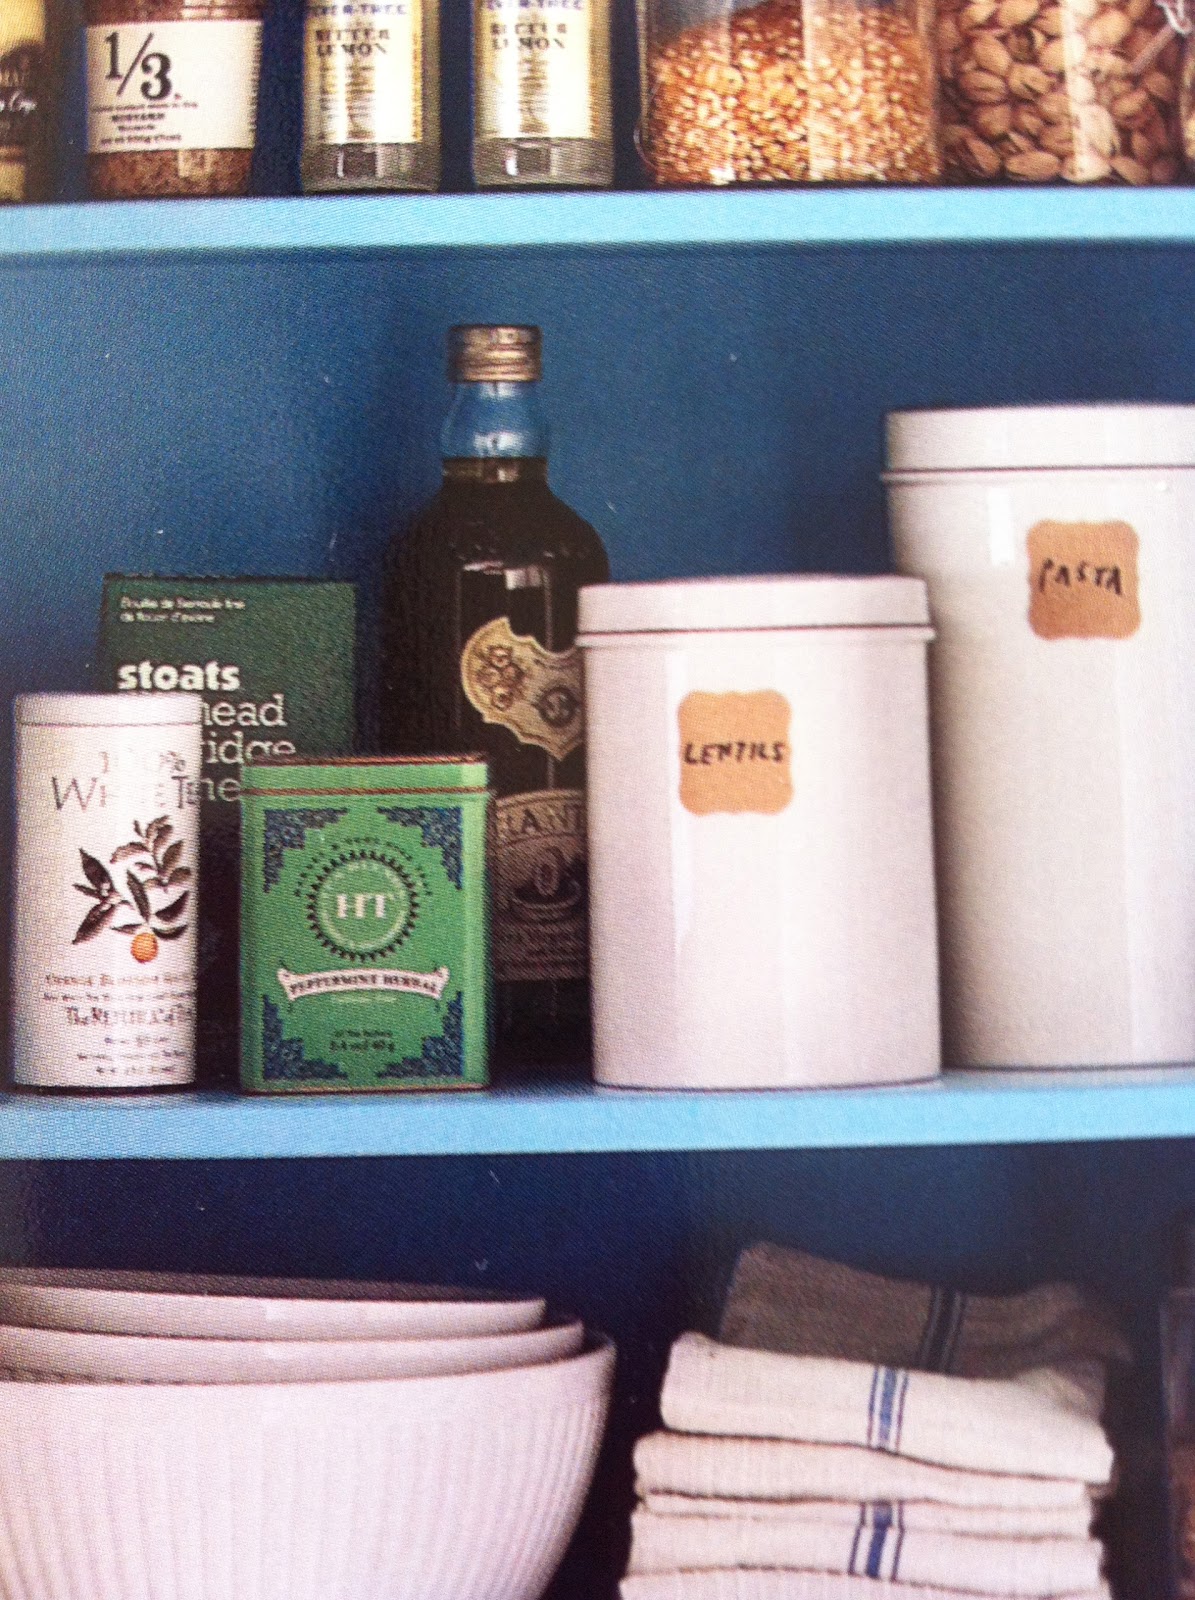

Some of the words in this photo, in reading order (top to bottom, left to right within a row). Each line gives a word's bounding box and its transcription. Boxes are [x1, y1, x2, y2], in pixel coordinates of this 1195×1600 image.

[1038, 558, 1122, 596] PASTA
[118, 661, 240, 691] stoats
[684, 741, 785, 765] LENTILS
